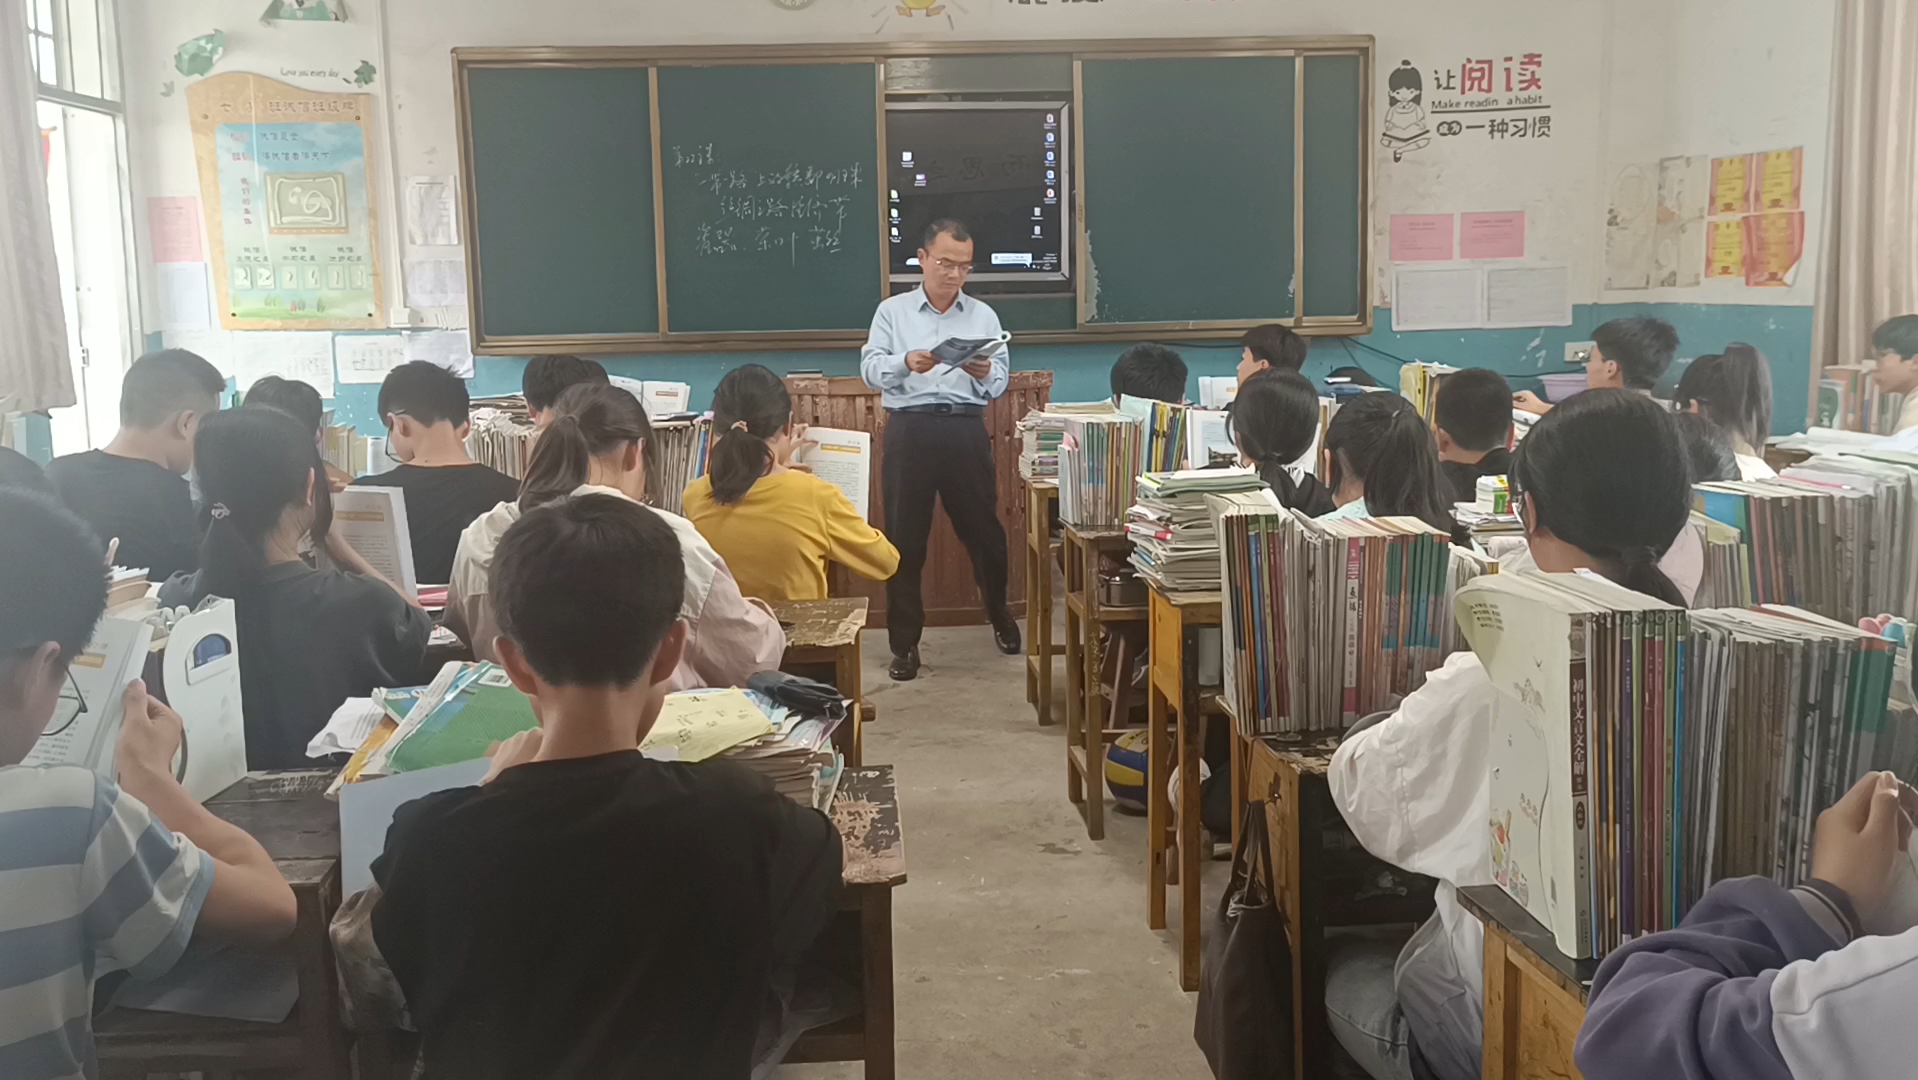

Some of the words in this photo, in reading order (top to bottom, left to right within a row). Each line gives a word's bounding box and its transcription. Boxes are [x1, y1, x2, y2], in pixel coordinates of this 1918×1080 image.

[1434, 53, 1543, 96] 让阅读
[1431, 100, 1461, 110] Make
[1464, 97, 1499, 109] readin
[1506, 97, 1513, 105] a
[1515, 95, 1543, 105] habit
